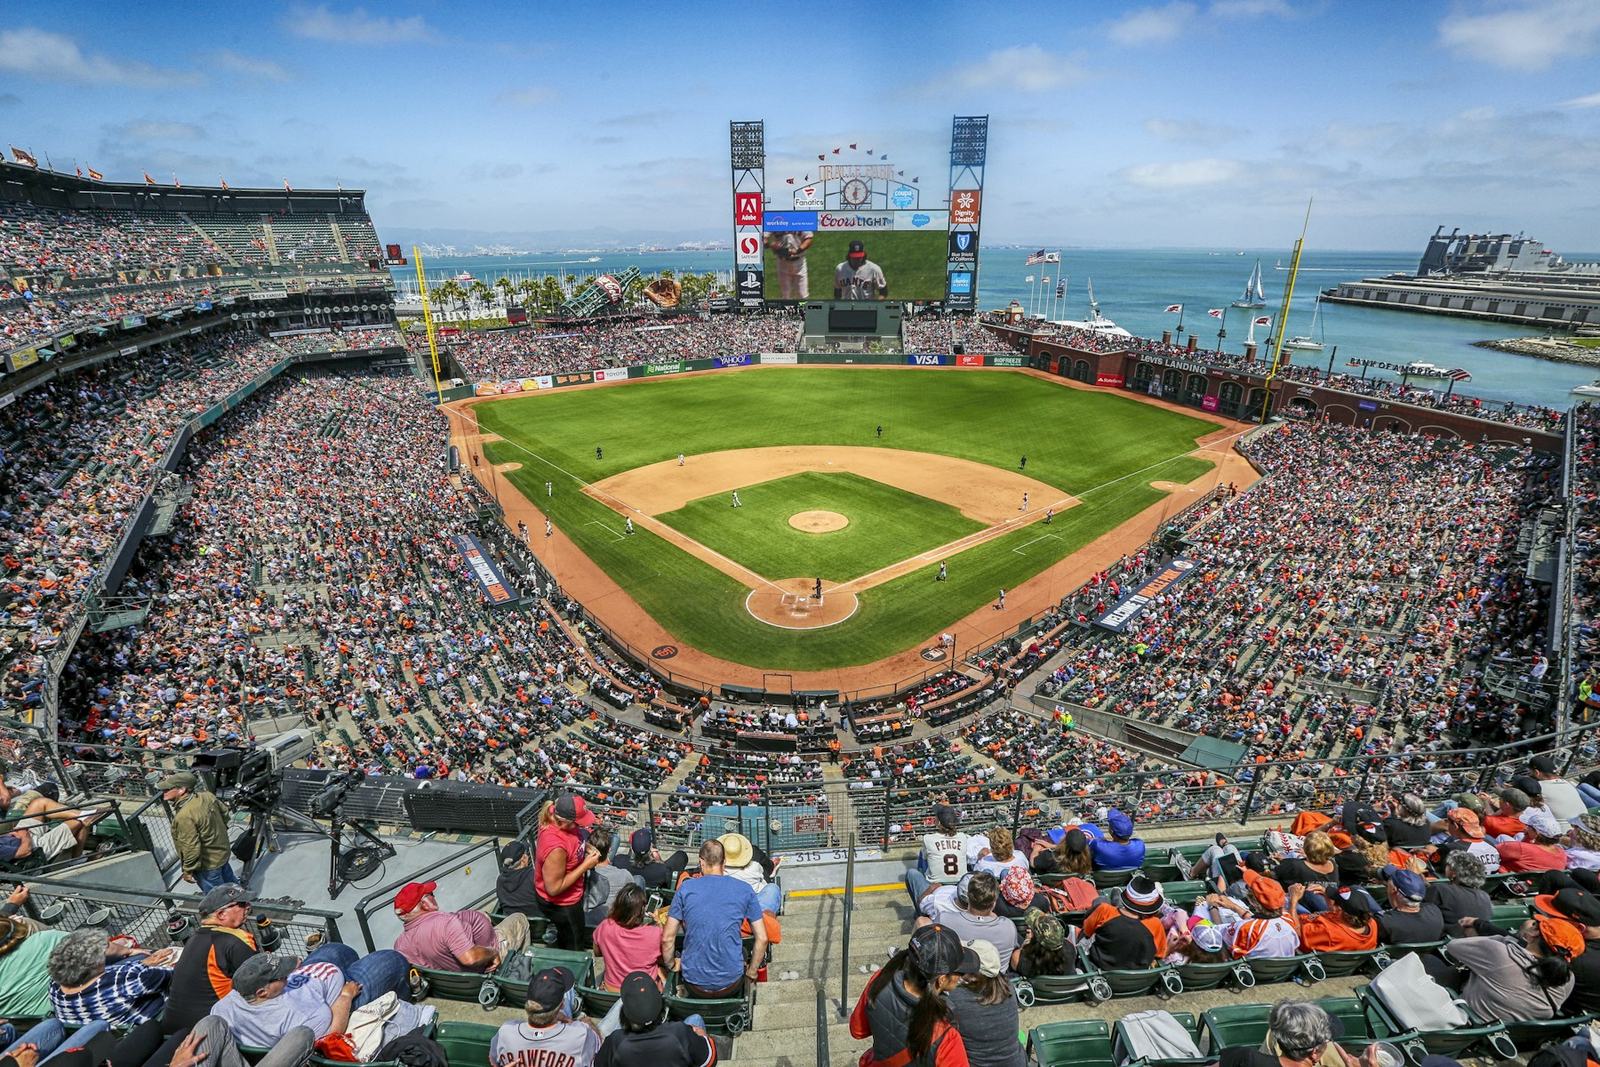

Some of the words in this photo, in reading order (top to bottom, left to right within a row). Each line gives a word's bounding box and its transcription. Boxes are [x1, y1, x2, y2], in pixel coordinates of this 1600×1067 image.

[795, 198, 824, 207] Fanatics
[954, 209, 975, 218] Dignity
[821, 214, 856, 227] Coors
[857, 216, 888, 227] LIGHT
[914, 355, 940, 365] VISA
[654, 362, 681, 372] National
[1164, 359, 1207, 375] LANDING
[1350, 357, 1377, 367] BANK
[1378, 361, 1393, 370] OF
[1393, 363, 1442, 378] AMERICA
[606, 370, 627, 378] TOYOTA
[935, 840, 962, 851] PENCE
[796, 851, 821, 862] 315
[943, 853, 959, 876] 8
